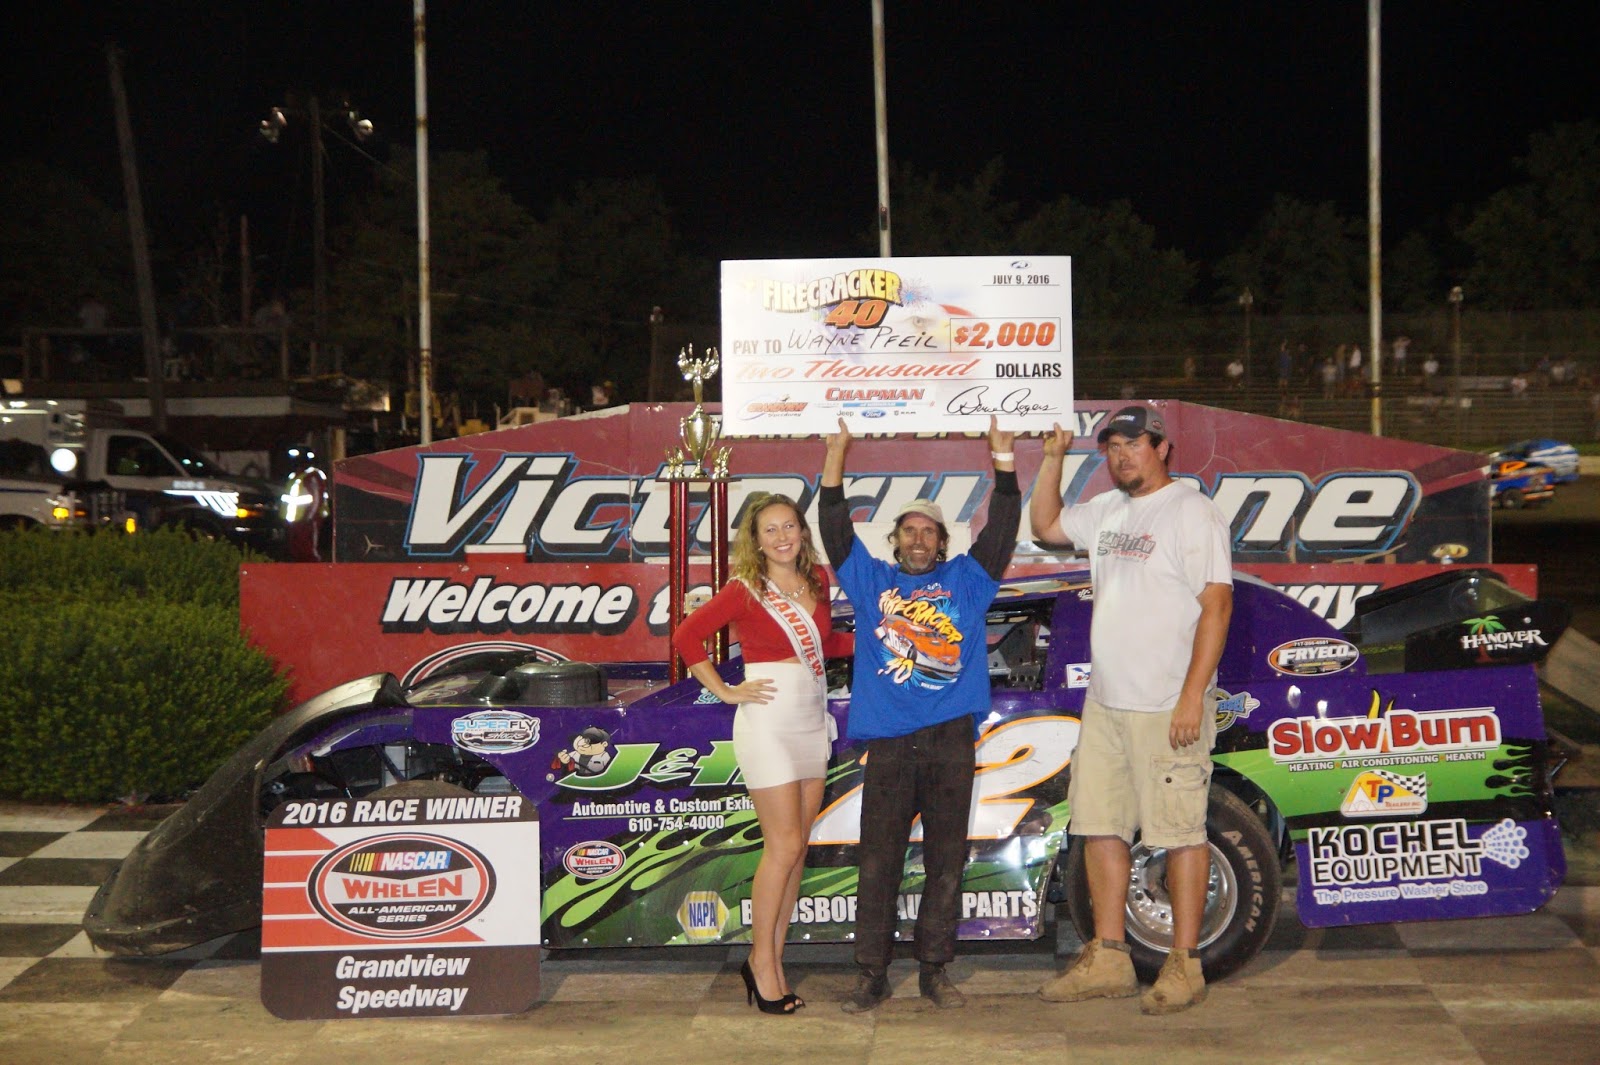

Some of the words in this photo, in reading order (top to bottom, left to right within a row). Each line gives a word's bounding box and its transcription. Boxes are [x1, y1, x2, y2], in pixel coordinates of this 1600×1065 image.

[762, 269, 903, 312] FIRECRACKER
[993, 275, 1012, 285] JULY
[1016, 275, 1024, 286] 9,
[1028, 275, 1050, 285] 2016
[824, 299, 889, 328] 40
[733, 340, 758, 354] PAY
[765, 339, 782, 353] TO
[788, 328, 864, 355] WAYNE
[954, 322, 1056, 349] $2,000
[803, 358, 982, 378] Thousand
[996, 363, 1061, 378] DOLLARS
[837, 410, 854, 418] Jeep
[1012, 452, 1420, 552] Lne
[381, 577, 634, 635] Welcome
[879, 588, 963, 643] FIRECRACKER
[1461, 629, 1549, 649] HANOVER
[1486, 642, 1523, 651] INN
[1278, 645, 1349, 666] FRYECO
[1272, 719, 1381, 756] Slow
[1389, 713, 1497, 748] Burn
[1288, 761, 1334, 772] HEATING
[1341, 759, 1360, 769] AIR
[1362, 755, 1439, 768] CONDITIONING
[1445, 752, 1486, 762] HEARTH
[282, 802, 348, 825] 2016
[352, 799, 419, 823] RACE
[426, 796, 523, 820] WINNER
[572, 801, 650, 816] Automotive
[655, 799, 665, 813] &
[669, 798, 721, 813] Custom
[726, 796, 755, 811] Exha
[628, 815, 725, 833] 610-754-4000
[1310, 820, 1482, 860] KOCHEL
[380, 851, 449, 871] NASCAR
[575, 857, 614, 866] WHELEN
[1312, 851, 1482, 884] EQUIPMENT
[342, 874, 463, 899] WHELEN
[1316, 891, 1340, 902] The
[1344, 887, 1398, 900] Pressure
[1402, 884, 1447, 897] Washer
[1452, 881, 1486, 894] Store
[348, 904, 457, 914] ALL-AMERICAN
[689, 902, 716, 928] NAPA
[962, 890, 1038, 918] PARTS
[376, 914, 427, 923] SERIES
[335, 953, 471, 979] Grandview
[336, 984, 469, 1014] Speedway
